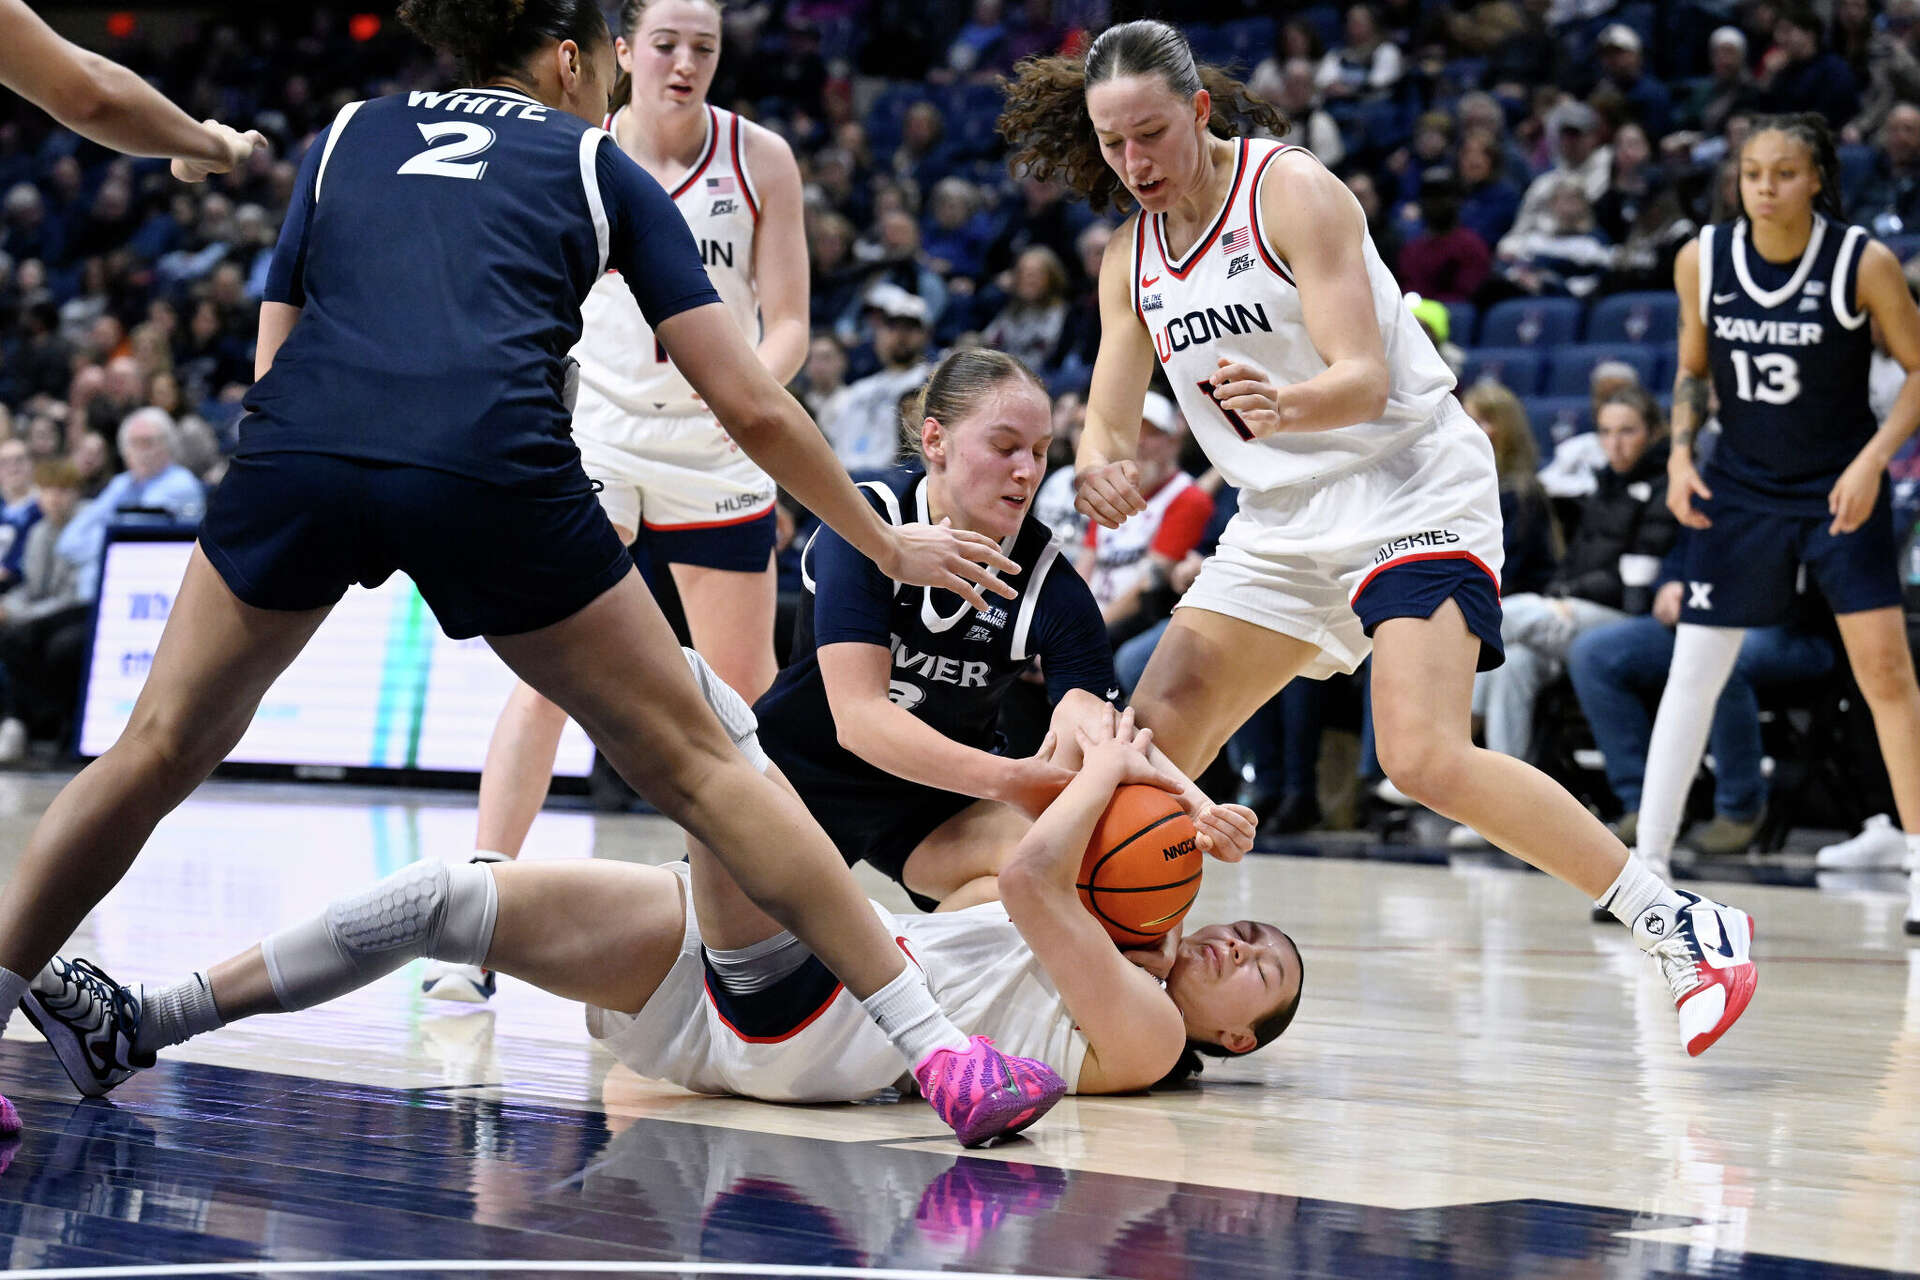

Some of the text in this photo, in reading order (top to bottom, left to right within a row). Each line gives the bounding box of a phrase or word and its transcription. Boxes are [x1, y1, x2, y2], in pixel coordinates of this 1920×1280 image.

[407, 90, 547, 122] WHITE
[397, 120, 497, 180] 2
[1228, 258, 1256, 275] EAST
[1231, 254, 1249, 267] BIG
[1142, 301, 1163, 312] CHANGE
[1151, 293, 1163, 301] THE
[1156, 303, 1273, 363] UCONN
[1713, 315, 1823, 346] XAVIER
[1730, 349, 1802, 405] 13
[1374, 529, 1460, 565] HUSKIES
[1688, 581, 1712, 610] X
[975, 611, 1007, 629] CHANGE
[994, 607, 1009, 621] THE
[970, 625, 991, 634] BIG
